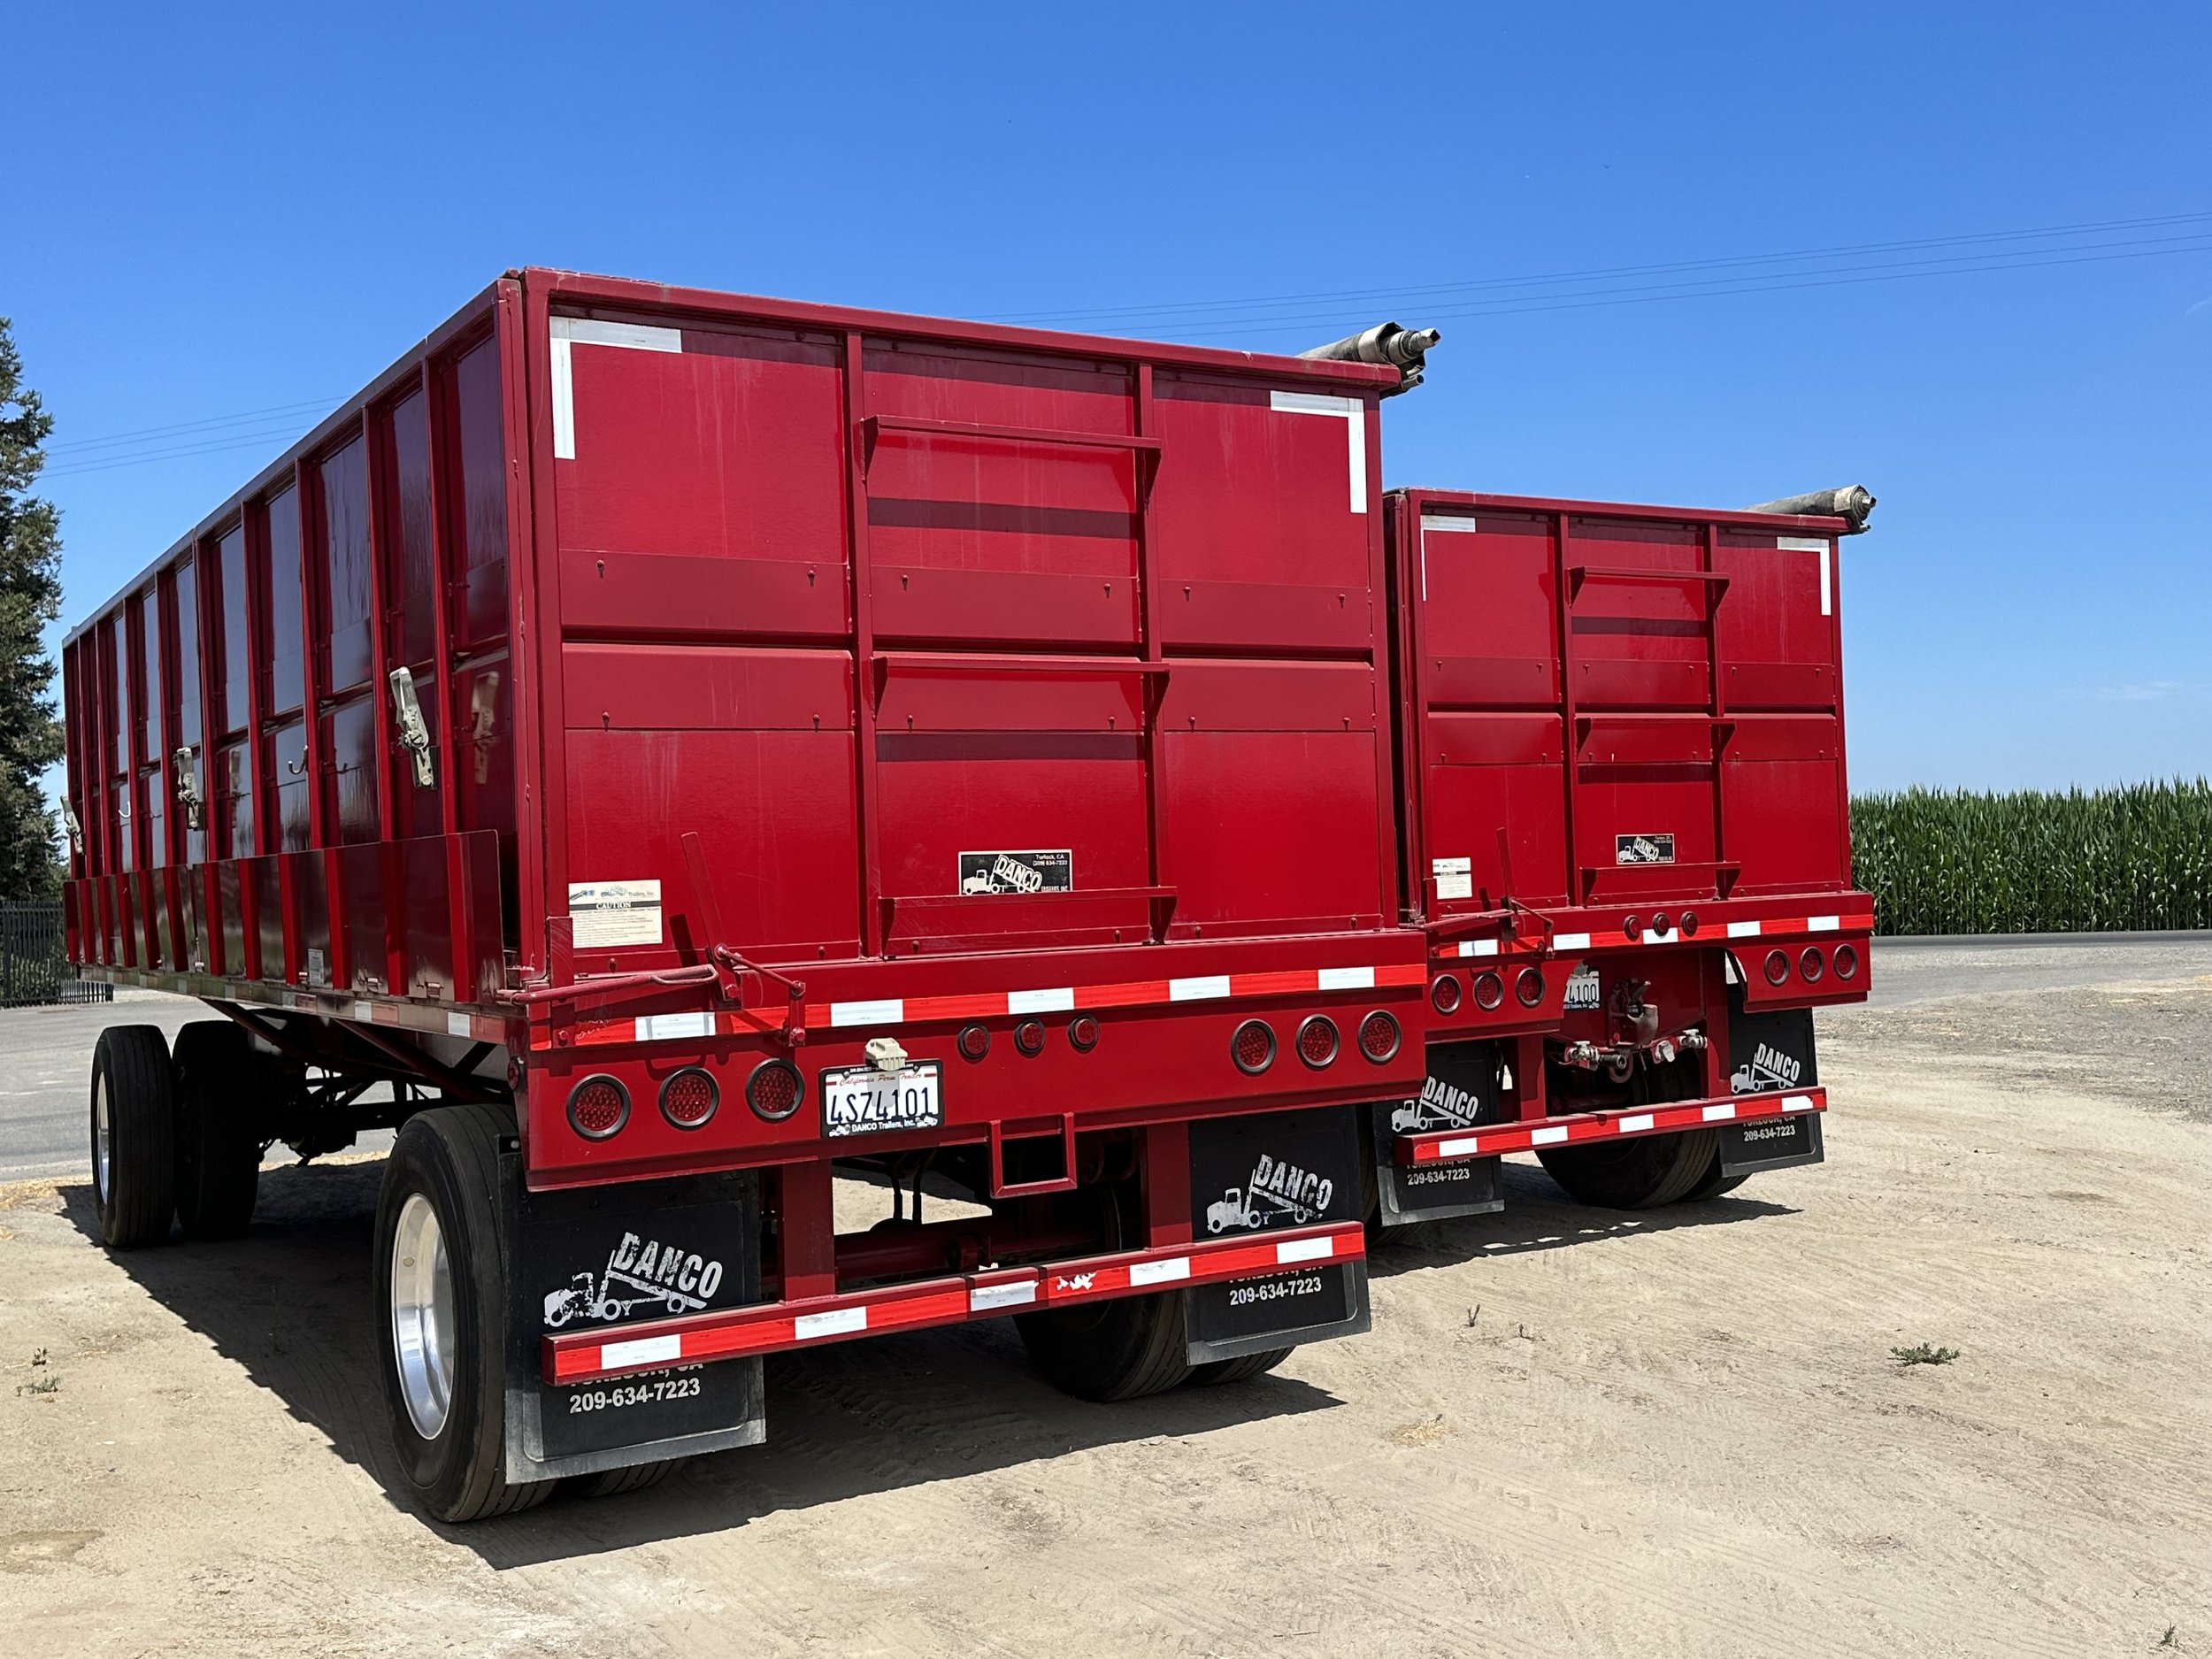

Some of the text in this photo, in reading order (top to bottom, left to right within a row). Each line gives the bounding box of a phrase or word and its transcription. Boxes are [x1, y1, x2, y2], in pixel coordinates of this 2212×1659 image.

[1635, 836, 1660, 860] DANCO
[994, 854, 1043, 891] DANCO
[1755, 1042, 1801, 1082] DANCO
[840, 1078, 874, 1087] California
[1423, 1075, 1479, 1120] DANCO
[830, 1087, 932, 1124] 4SZ4101
[851, 1122, 878, 1133] DANCO
[1743, 1125, 1796, 1142] 209-634-7223
[1254, 1153, 1333, 1210] DANCO
[1407, 1168, 1471, 1186] 209-634-7223
[612, 1231, 723, 1299] DANCO
[1229, 1276, 1322, 1306] 209-634-7223
[569, 1377, 701, 1414] 209-634-7223
